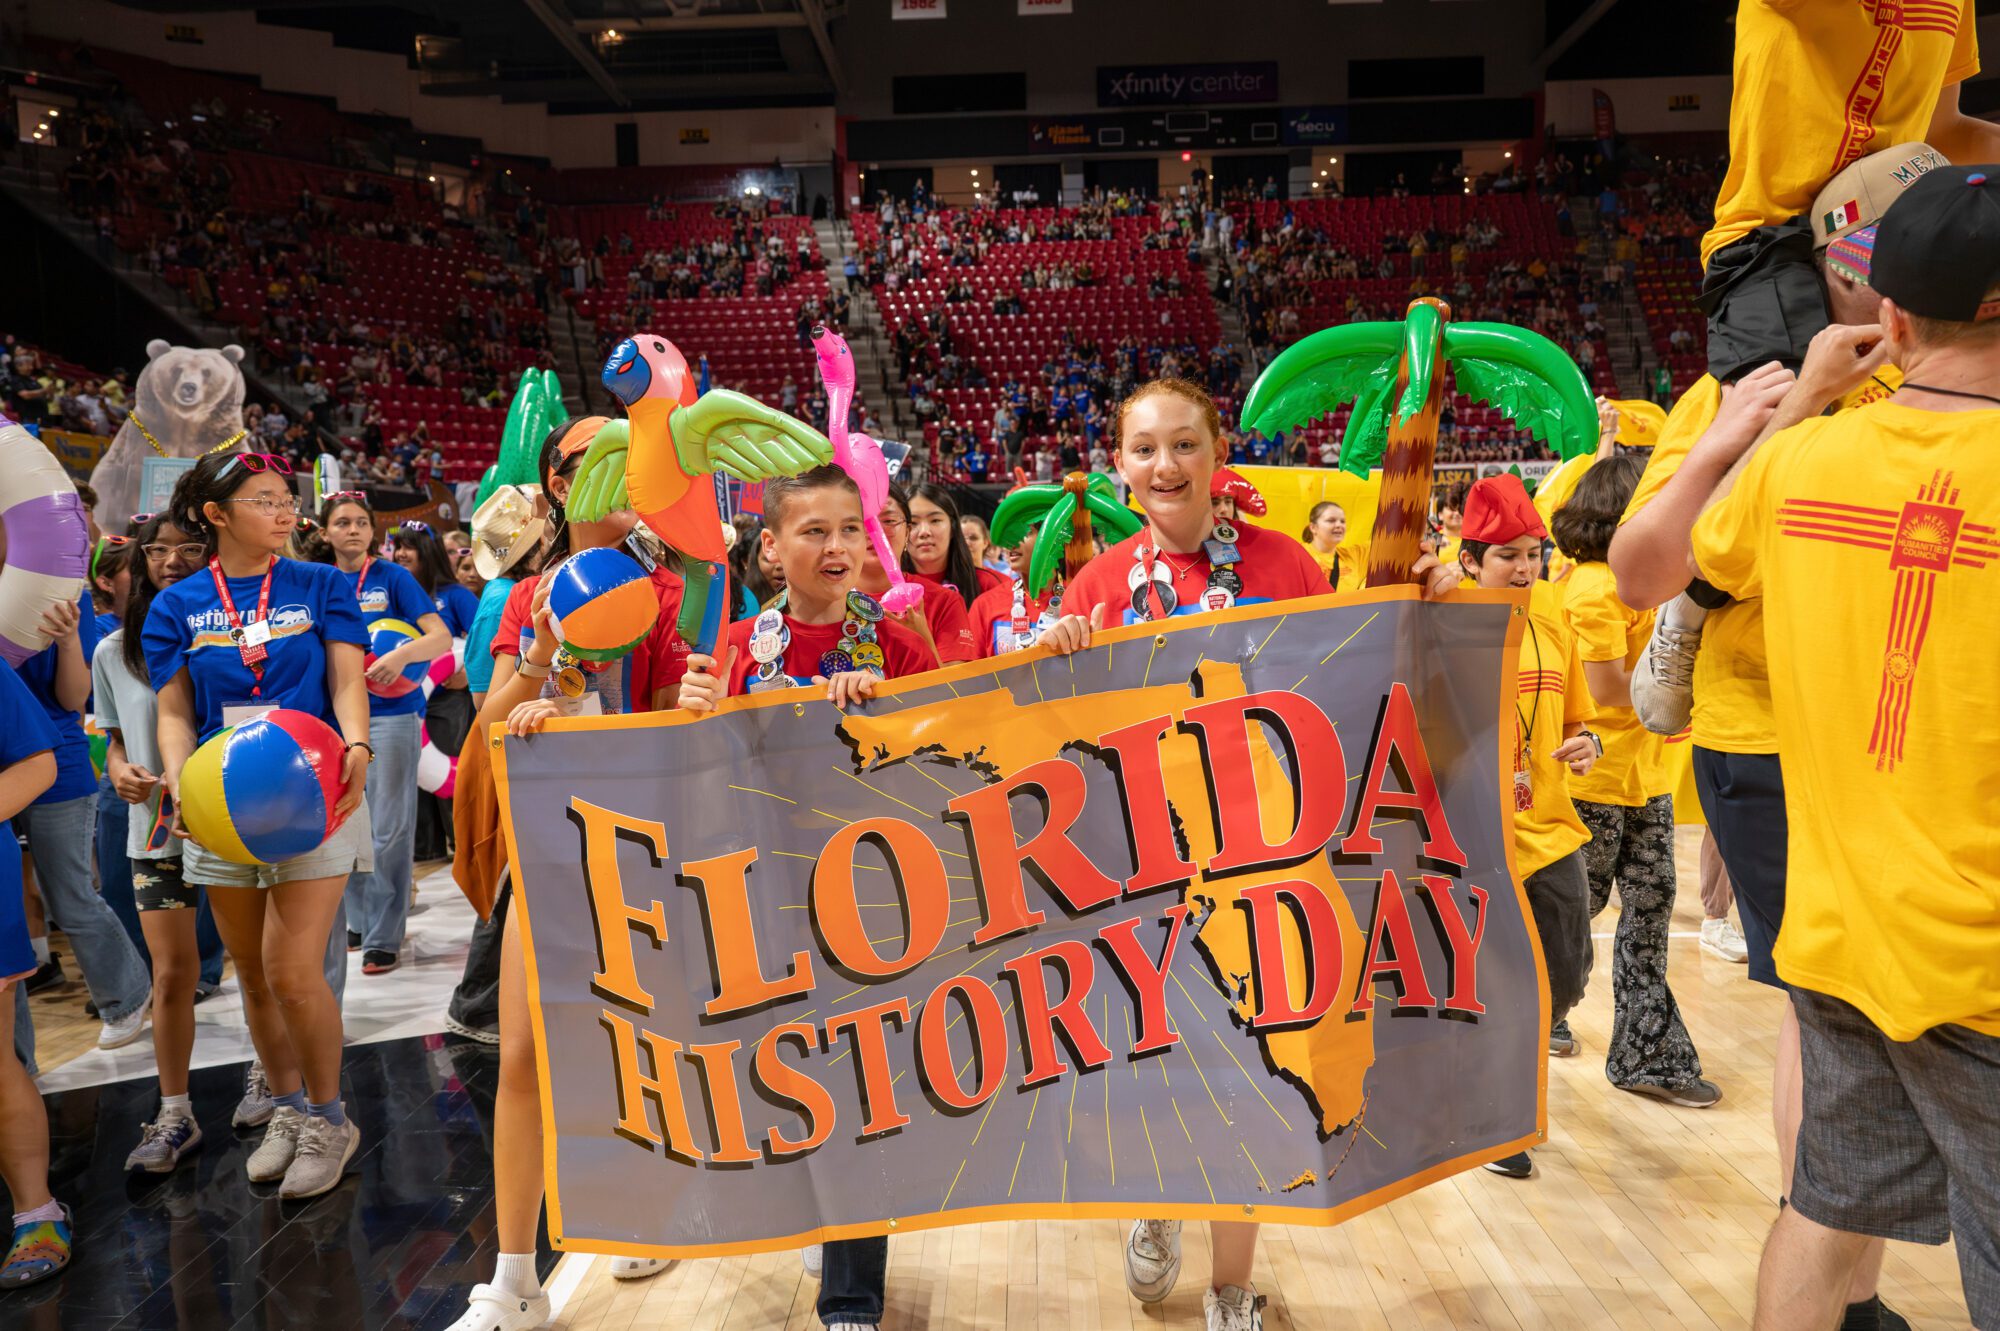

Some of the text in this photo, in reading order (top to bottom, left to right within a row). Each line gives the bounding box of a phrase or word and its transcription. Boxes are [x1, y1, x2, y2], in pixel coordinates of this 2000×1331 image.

[1878, 8, 1897, 21] DAY
[1109, 70, 1265, 100] xfinity center
[1864, 48, 1889, 92] NEW
[1296, 121, 1336, 133] secu
[1901, 513, 1951, 544] NEW MEXICO
[1897, 538, 1950, 555] HUMANITIES
[1902, 547, 1940, 561] COUNCIL
[567, 681, 1469, 1023] FLORIDA
[600, 868, 1491, 1170] HISTORY DAY
